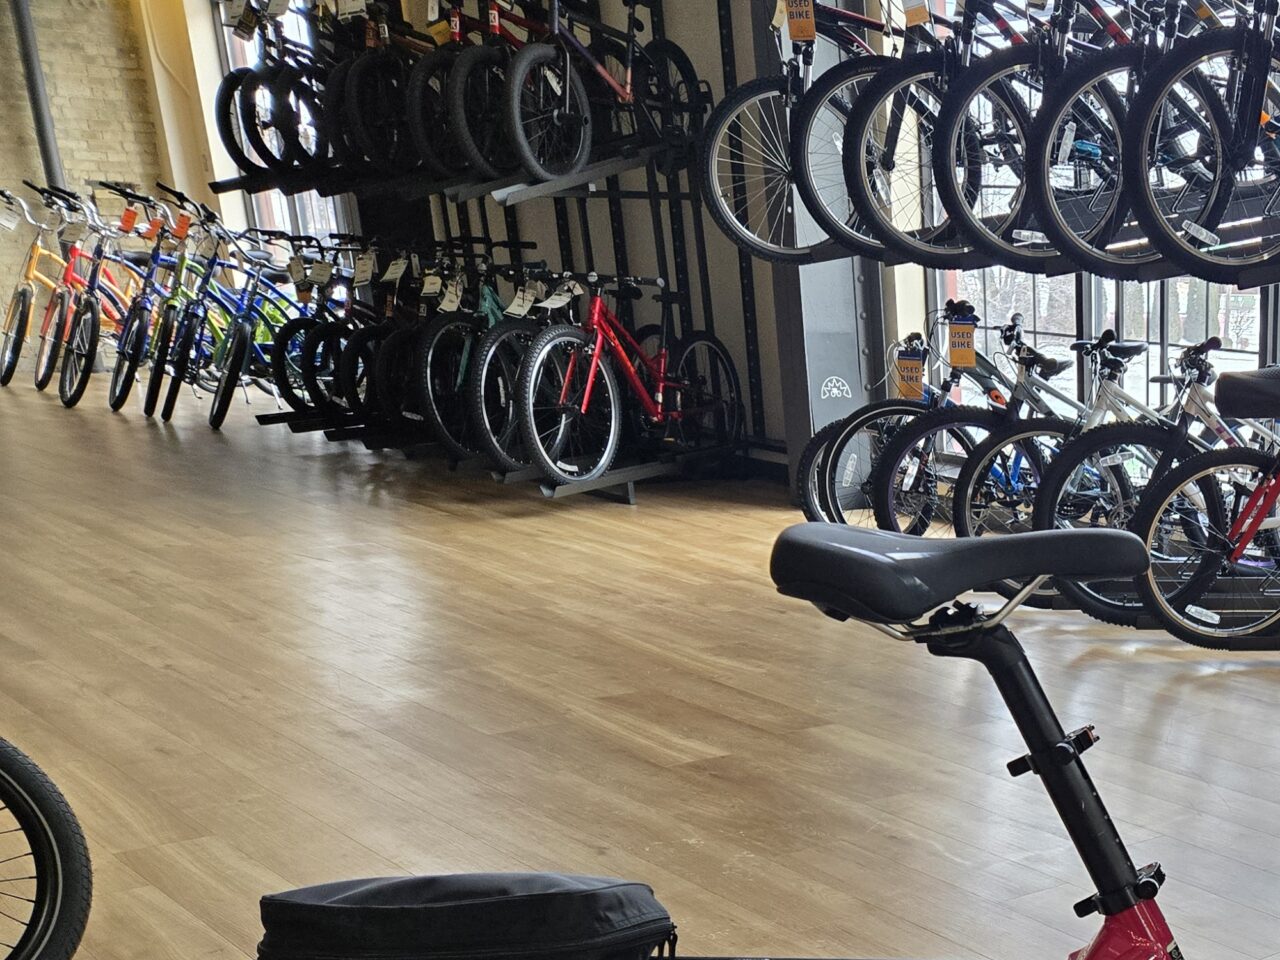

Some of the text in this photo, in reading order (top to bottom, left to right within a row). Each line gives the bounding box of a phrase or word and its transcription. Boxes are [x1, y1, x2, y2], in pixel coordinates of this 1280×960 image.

[789, 9, 811, 20] BIKE
[951, 331, 972, 339] USED
[951, 341, 972, 349] BIKE
[900, 366, 920, 374] USED
[900, 375, 921, 383] BIKE
